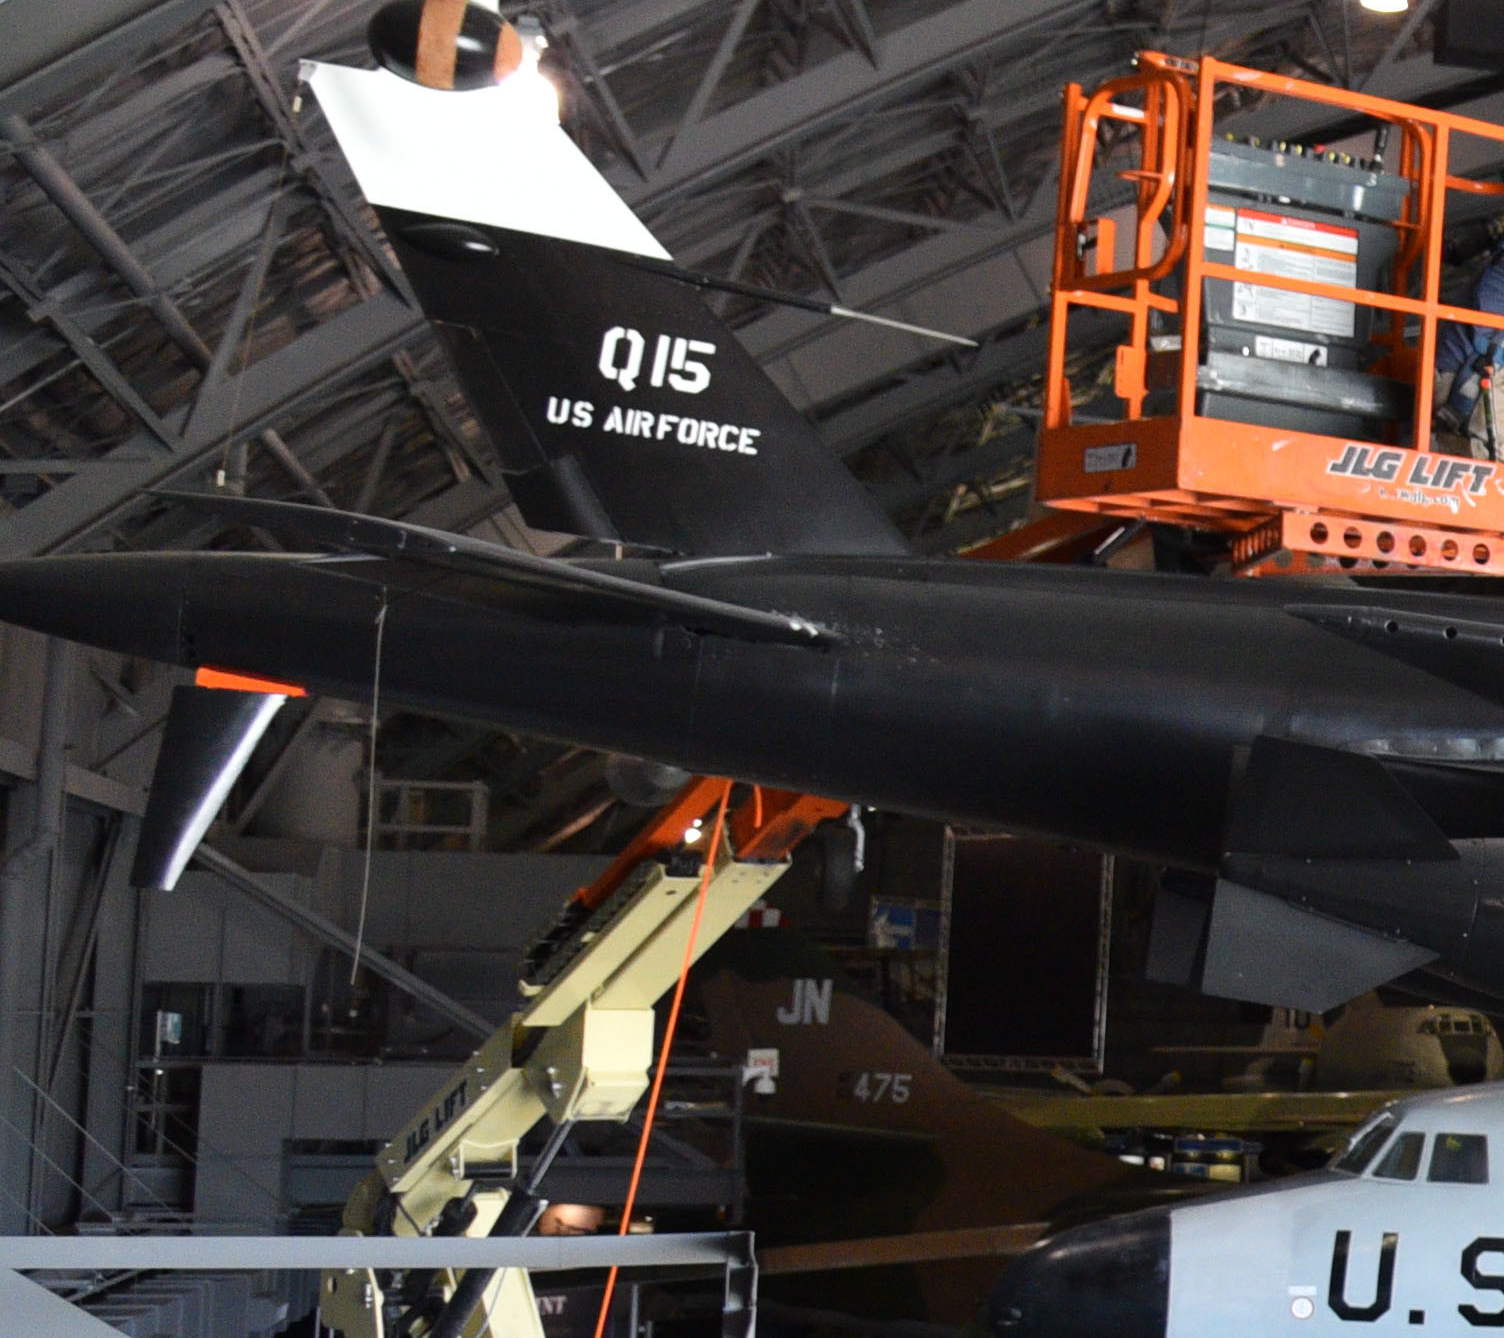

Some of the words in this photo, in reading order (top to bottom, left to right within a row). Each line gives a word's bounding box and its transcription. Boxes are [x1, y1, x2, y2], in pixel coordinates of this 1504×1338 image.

[598, 325, 717, 395] Q15
[546, 396, 594, 428] US
[602, 406, 655, 438] AIR
[656, 413, 761, 455] FORCE
[1327, 443, 1404, 481] JLG
[1408, 456, 1496, 495] LIFT
[777, 978, 834, 1025] JN
[854, 1072, 912, 1103] 475
